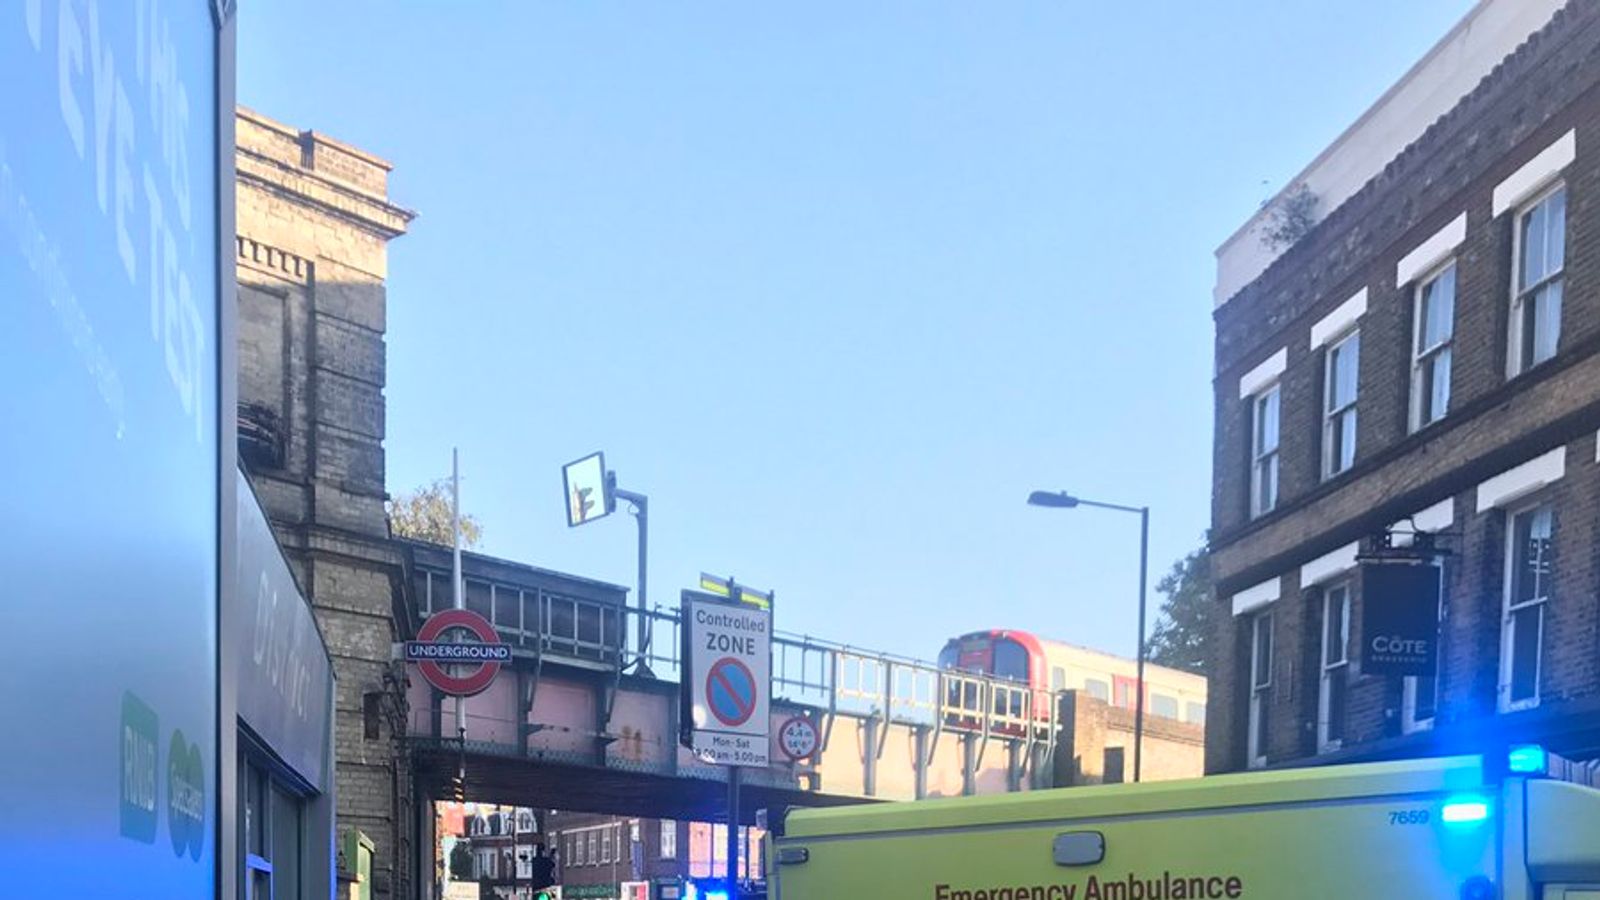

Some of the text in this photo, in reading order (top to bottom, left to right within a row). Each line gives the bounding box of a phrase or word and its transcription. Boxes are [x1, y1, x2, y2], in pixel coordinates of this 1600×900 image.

[143, 161, 205, 445] TEST
[696, 609, 766, 632] Controlled
[409, 645, 507, 658] UNDERGROUND
[706, 632, 755, 656] ZONE
[1388, 809, 1429, 826] 7659
[1084, 870, 1242, 900] Ambulance
